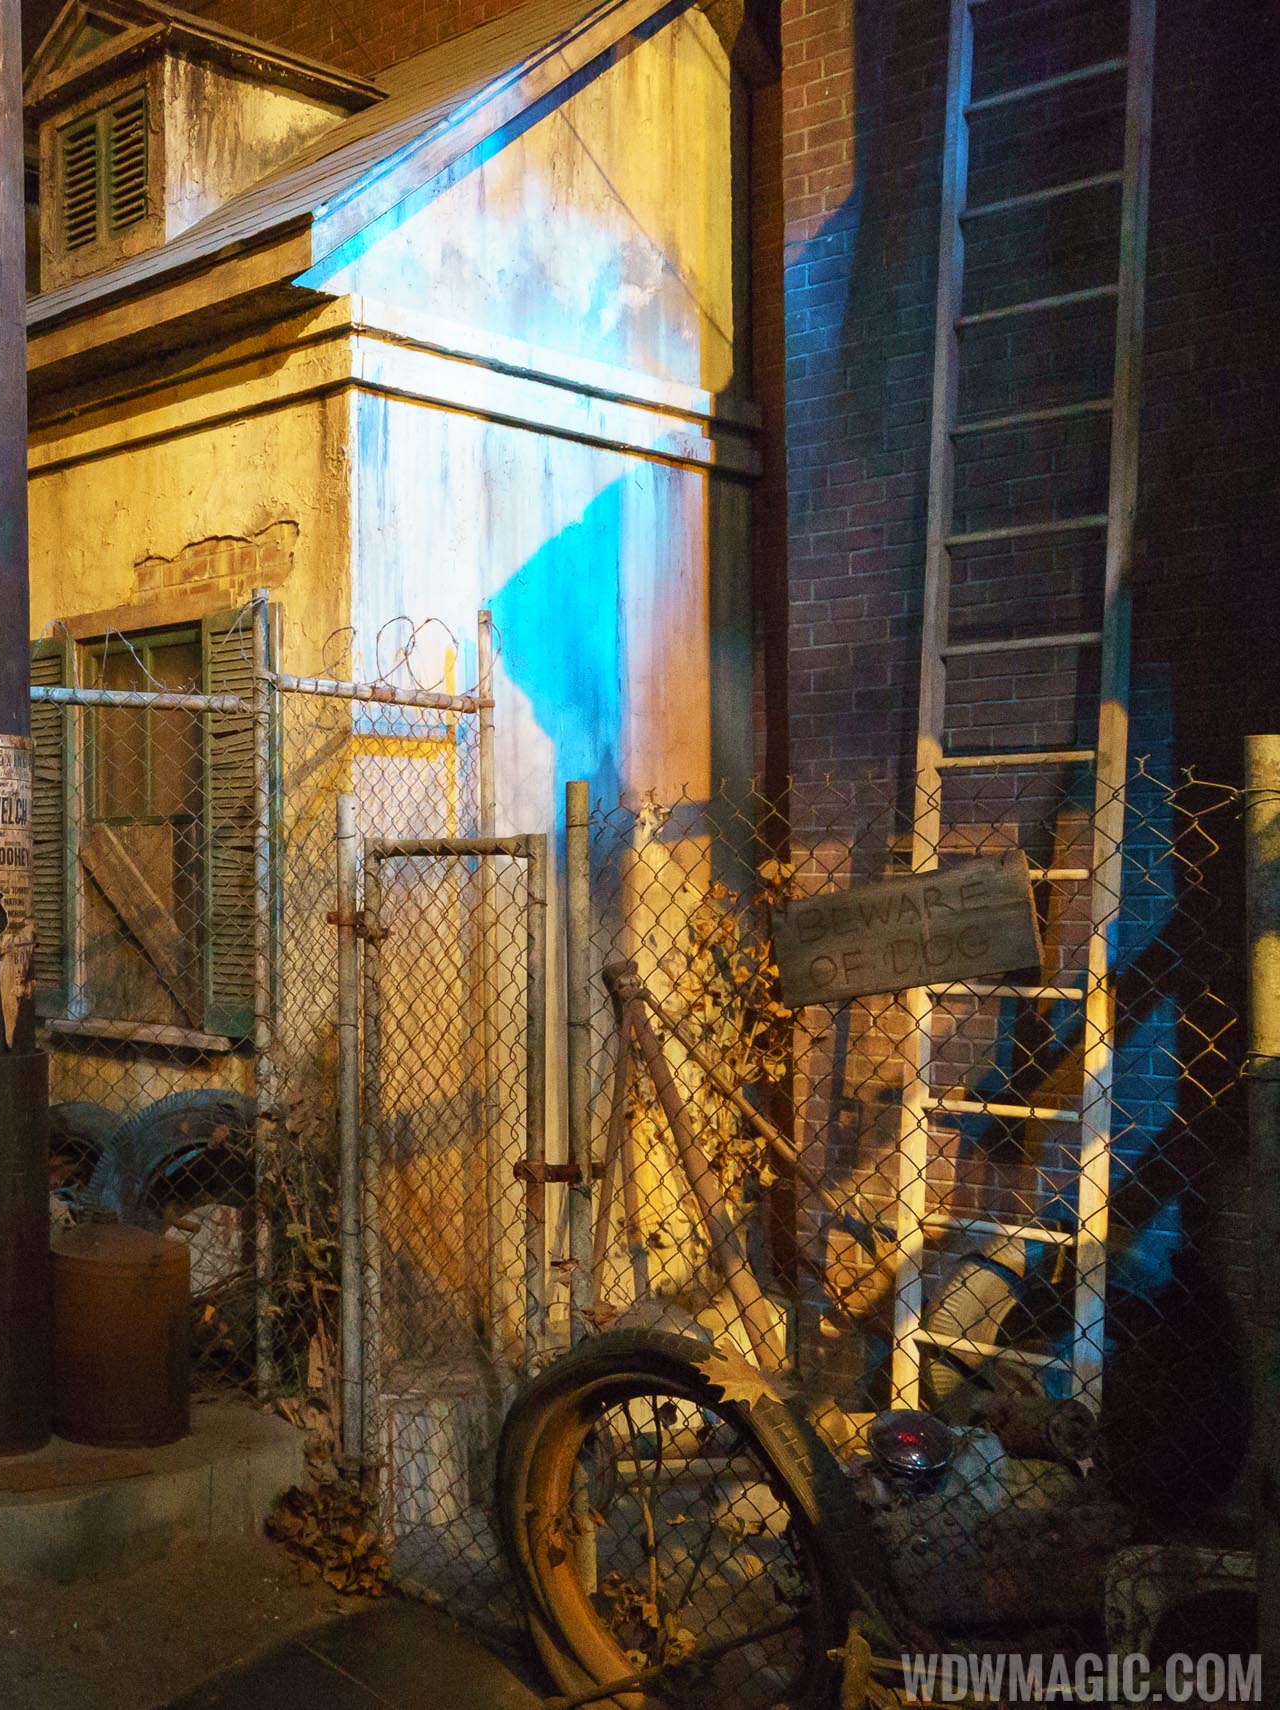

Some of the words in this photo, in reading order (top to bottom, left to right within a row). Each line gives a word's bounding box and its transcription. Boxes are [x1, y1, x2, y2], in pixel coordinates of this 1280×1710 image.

[795, 880, 987, 944] BEWARE
[809, 951, 864, 988] OF
[882, 925, 992, 975] DOG
